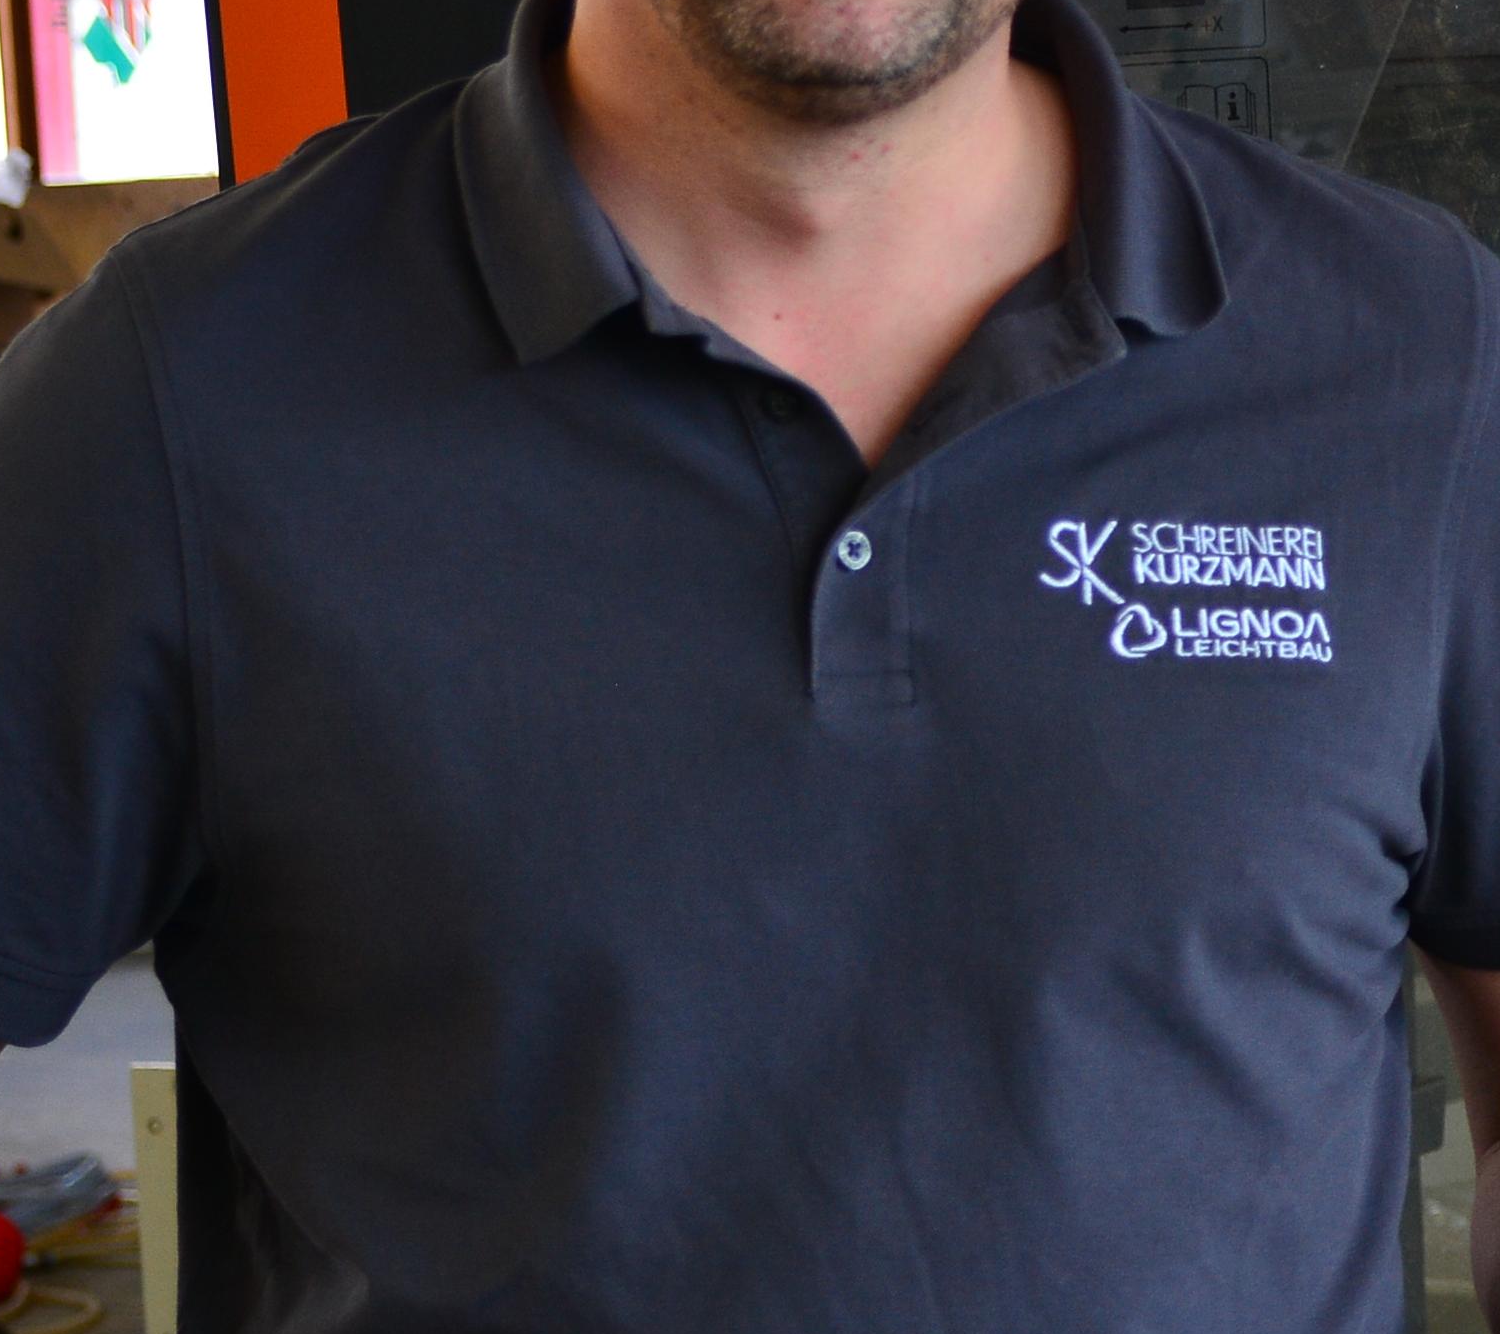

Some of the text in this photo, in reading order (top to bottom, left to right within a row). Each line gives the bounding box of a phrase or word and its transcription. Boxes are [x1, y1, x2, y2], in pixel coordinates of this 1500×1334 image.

[1130, 522, 1323, 560] SCHREINEREI
[1039, 517, 1126, 605] SK
[1133, 553, 1326, 590] KURZMANN
[1175, 638, 1332, 663] LEICHTBAU
